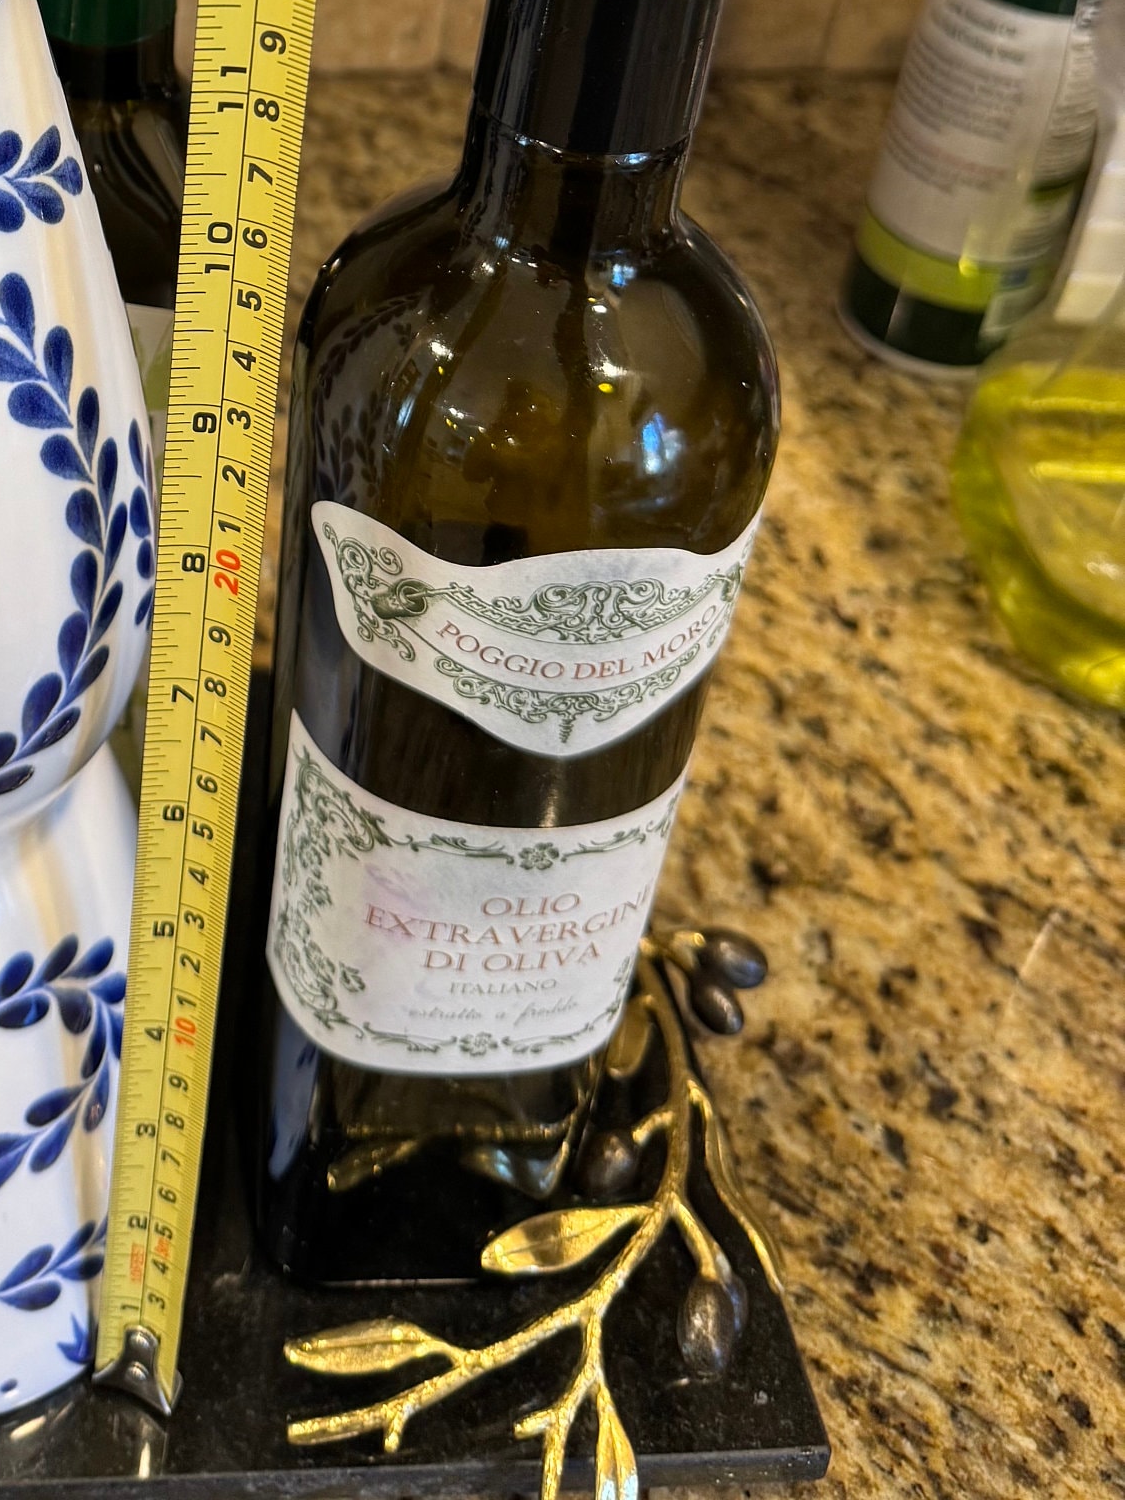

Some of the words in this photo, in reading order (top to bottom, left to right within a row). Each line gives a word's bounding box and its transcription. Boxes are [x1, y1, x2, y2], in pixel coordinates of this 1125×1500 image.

[259, 30, 287, 56] 9
[254, 97, 280, 122] 8
[248, 162, 274, 187] 7
[242, 228, 268, 251] 6
[236, 289, 263, 313] 5
[232, 350, 257, 372] 4
[192, 411, 218, 434] 9
[226, 406, 252, 430] 3
[222, 464, 247, 488] 2
[217, 518, 242, 535] 1
[181, 552, 205, 573] 8
[214, 549, 242, 596] 20
[208, 625, 232, 648] 9
[435, 619, 565, 680] POGGIO
[571, 656, 634, 681] DEL
[641, 604, 718, 668] MORO
[171, 684, 194, 706] 7
[204, 676, 227, 699] 8
[200, 725, 224, 748] 7
[195, 773, 218, 795] 6
[162, 804, 186, 822] 6
[191, 821, 215, 842] 5
[188, 866, 209, 887] 4
[480, 892, 582, 917] OLIO
[153, 921, 175, 939] 5
[184, 910, 205, 932] 3
[180, 954, 201, 975] 2
[420, 949, 466, 972] DI
[481, 940, 601, 972] OLIVA
[448, 978, 559, 997] ITALIANO
[177, 994, 198, 1009] 1
[494, 1010, 507, 1021] a
[144, 1026, 166, 1044] 4
[175, 1017, 197, 1049] 10
[169, 1074, 190, 1093] 9
[136, 1122, 157, 1138] 3
[165, 1113, 186, 1132] 8
[161, 1151, 182, 1170] 7
[158, 1186, 178, 1205] 6
[127, 1215, 147, 1230] 2
[154, 1221, 173, 1240] 5
[151, 1258, 169, 1275] 4
[120, 1303, 139, 1311] 1
[148, 1292, 165, 1310] 3
